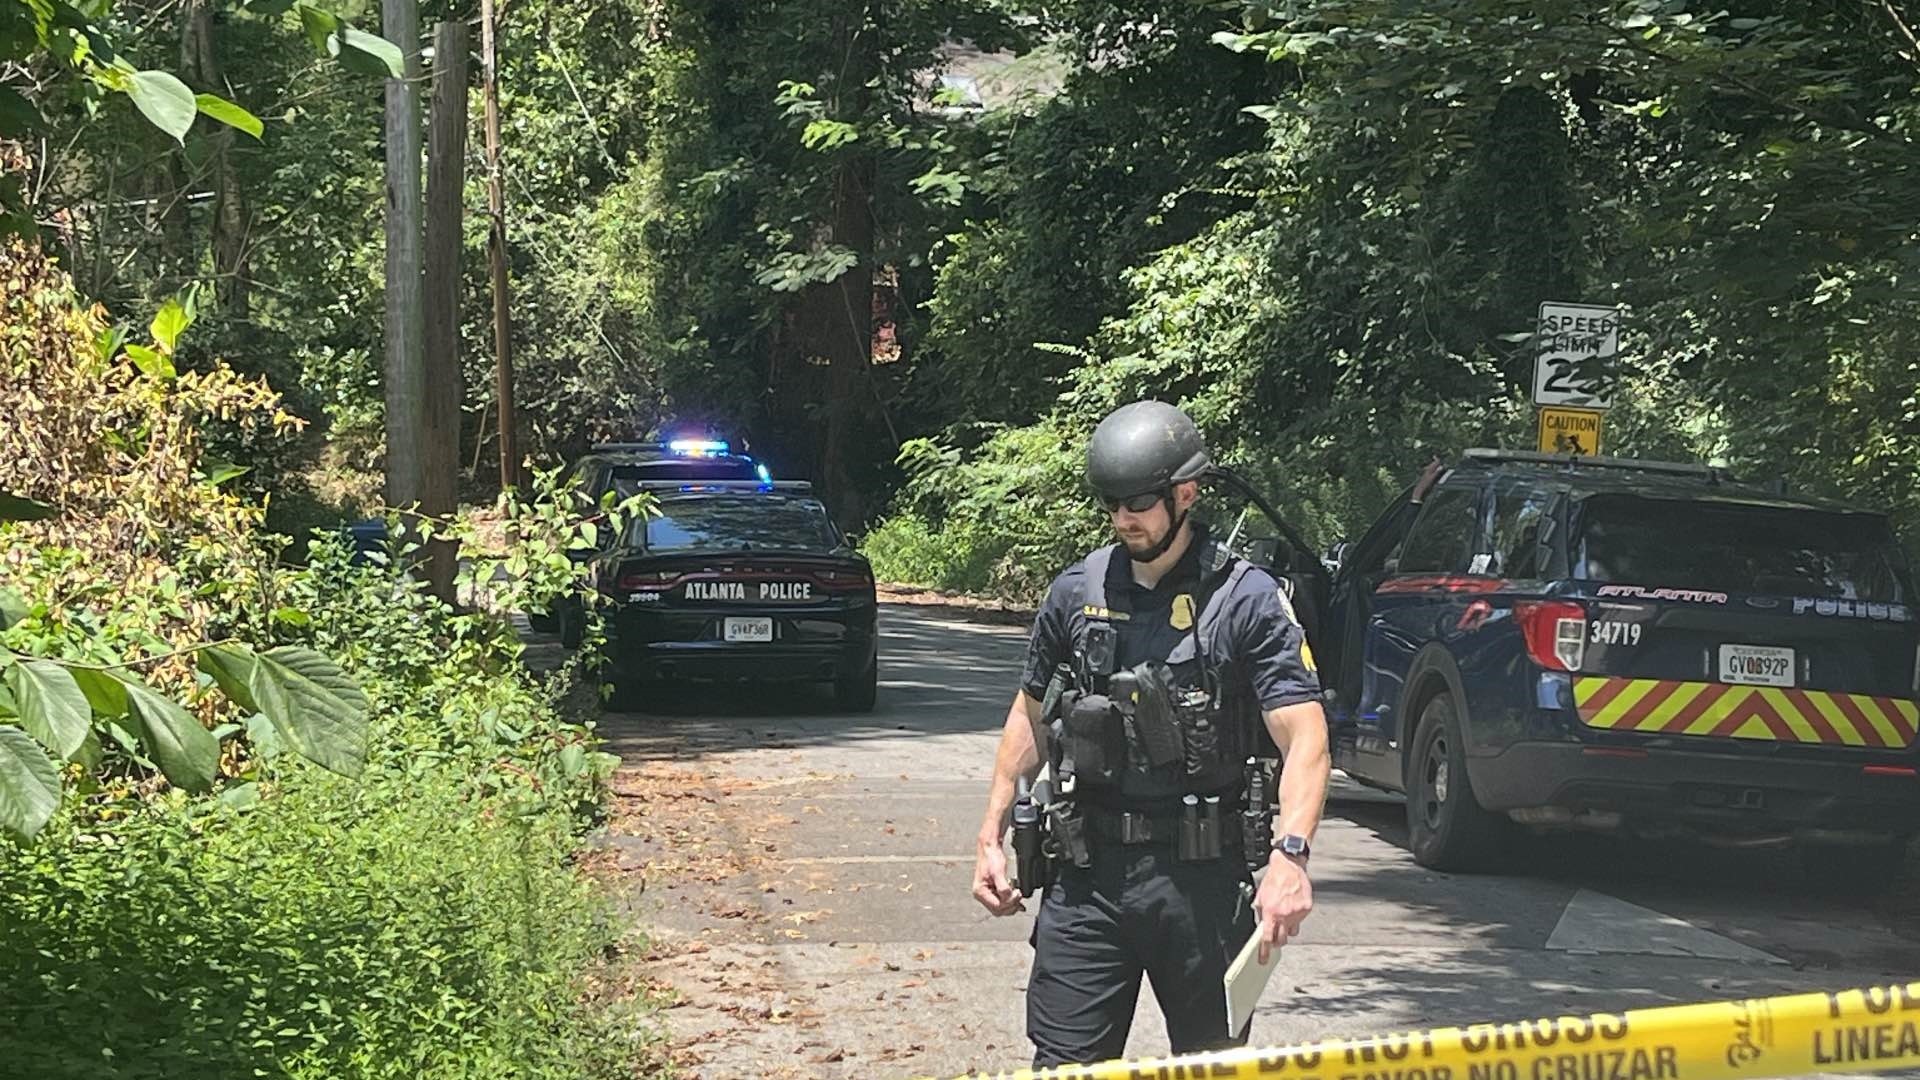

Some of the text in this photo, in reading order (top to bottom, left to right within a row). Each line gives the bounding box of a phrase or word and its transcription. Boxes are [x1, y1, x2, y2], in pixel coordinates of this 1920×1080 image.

[1547, 315, 1613, 333] SPEED
[1544, 358, 1604, 396] 2
[1546, 415, 1596, 432] CAUTION
[685, 583, 811, 600] ATLANTA POLICE
[1596, 585, 1728, 604] ATLANTA
[1591, 621, 1641, 645] 34719
[1813, 1021, 1920, 1064] LINEA
[1532, 1046, 1678, 1080] CRUZAR
